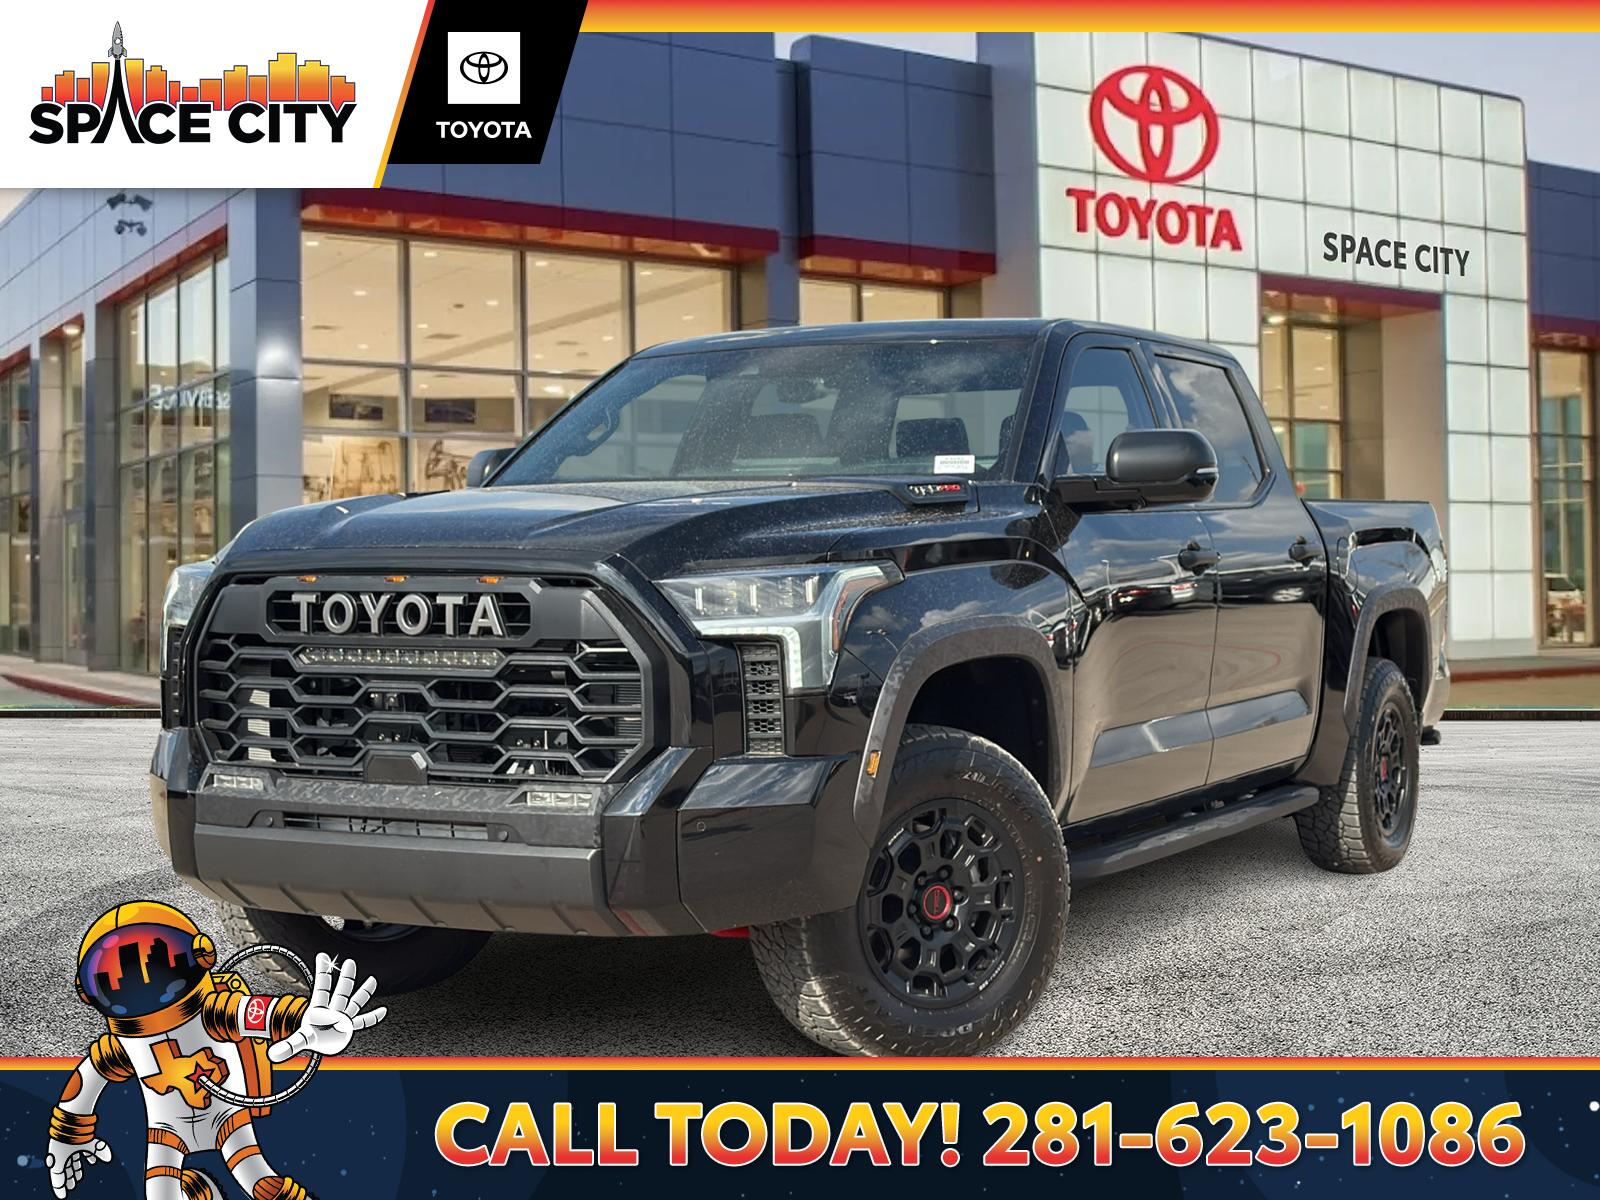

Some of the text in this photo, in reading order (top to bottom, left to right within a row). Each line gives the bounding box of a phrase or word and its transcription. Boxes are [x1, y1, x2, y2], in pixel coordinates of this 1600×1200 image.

[1066, 188, 1243, 251] TOYOTA
[1323, 232, 1470, 276] SPACE CITY
[291, 592, 508, 638] TOYOTA
